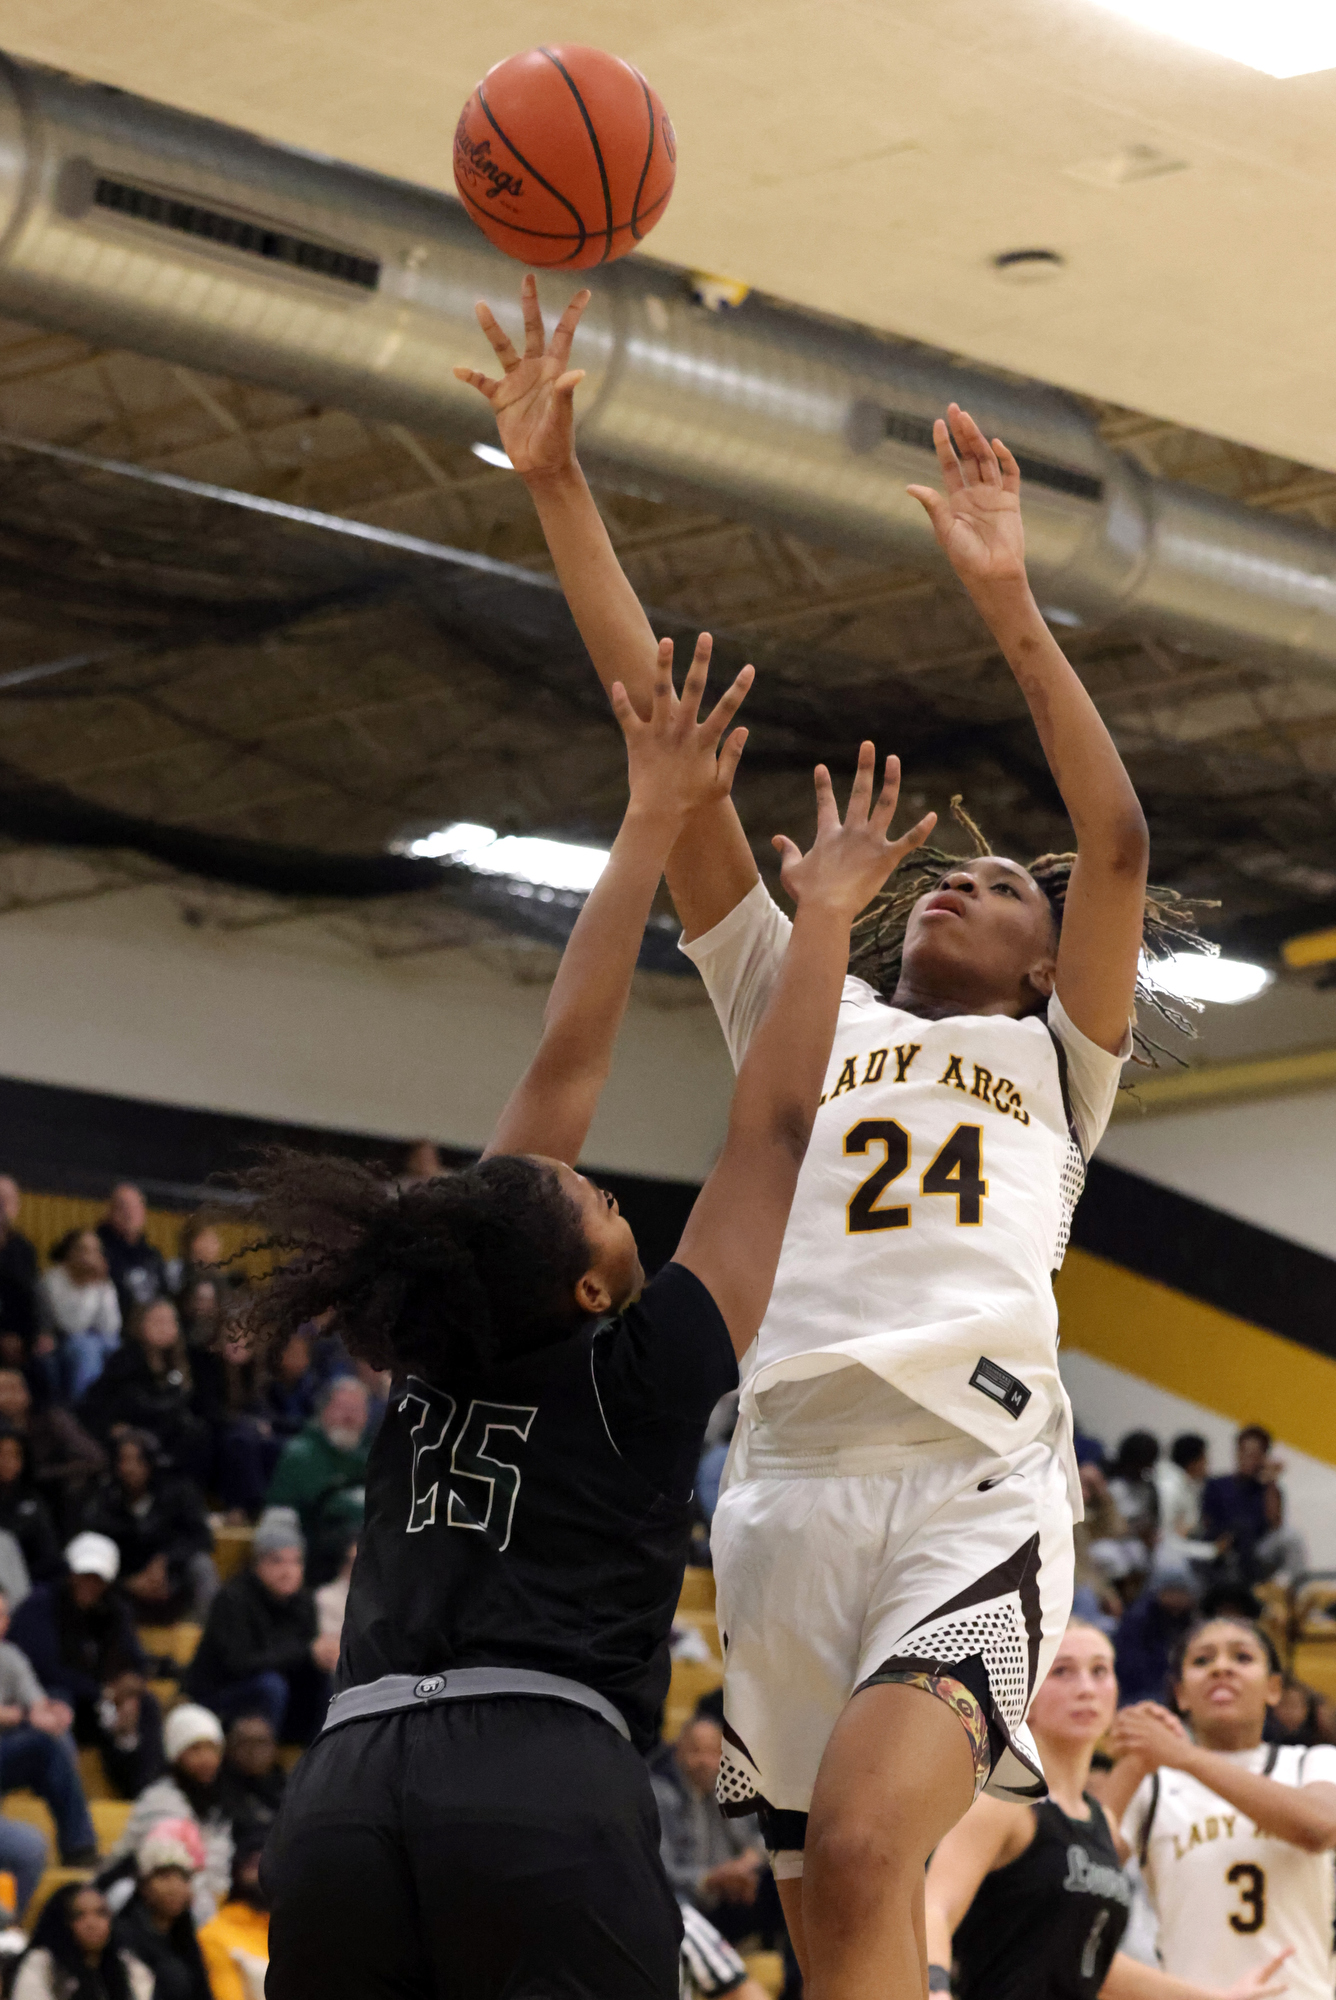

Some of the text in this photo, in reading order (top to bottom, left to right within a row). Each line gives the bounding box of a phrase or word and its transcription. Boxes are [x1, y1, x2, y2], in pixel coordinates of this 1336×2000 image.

[937, 1053, 1030, 1126] ARCS
[843, 1117, 989, 1235] 24
[398, 1374, 538, 1552] 25
[1172, 1815, 1235, 1860] LADY
[1225, 1861, 1267, 1935] 3
